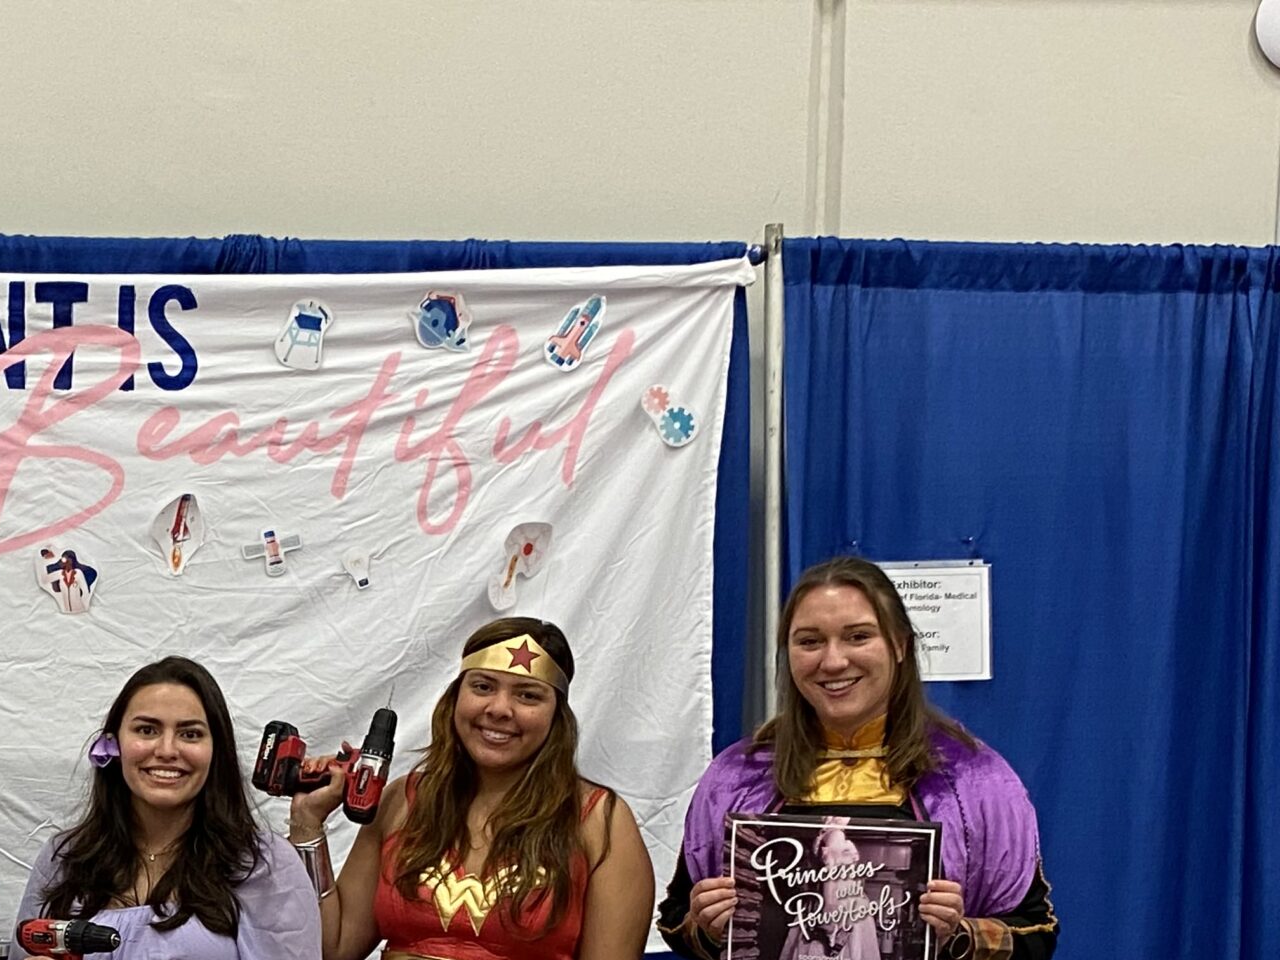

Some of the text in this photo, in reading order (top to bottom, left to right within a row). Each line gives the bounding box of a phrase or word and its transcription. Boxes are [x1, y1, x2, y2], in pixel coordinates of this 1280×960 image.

[119, 283, 199, 391] IS
[944, 592, 977, 600] Medical
[921, 644, 950, 653] Family
[750, 837, 885, 905] Princesses
[835, 881, 864, 899] with
[784, 885, 911, 946] Powertools
